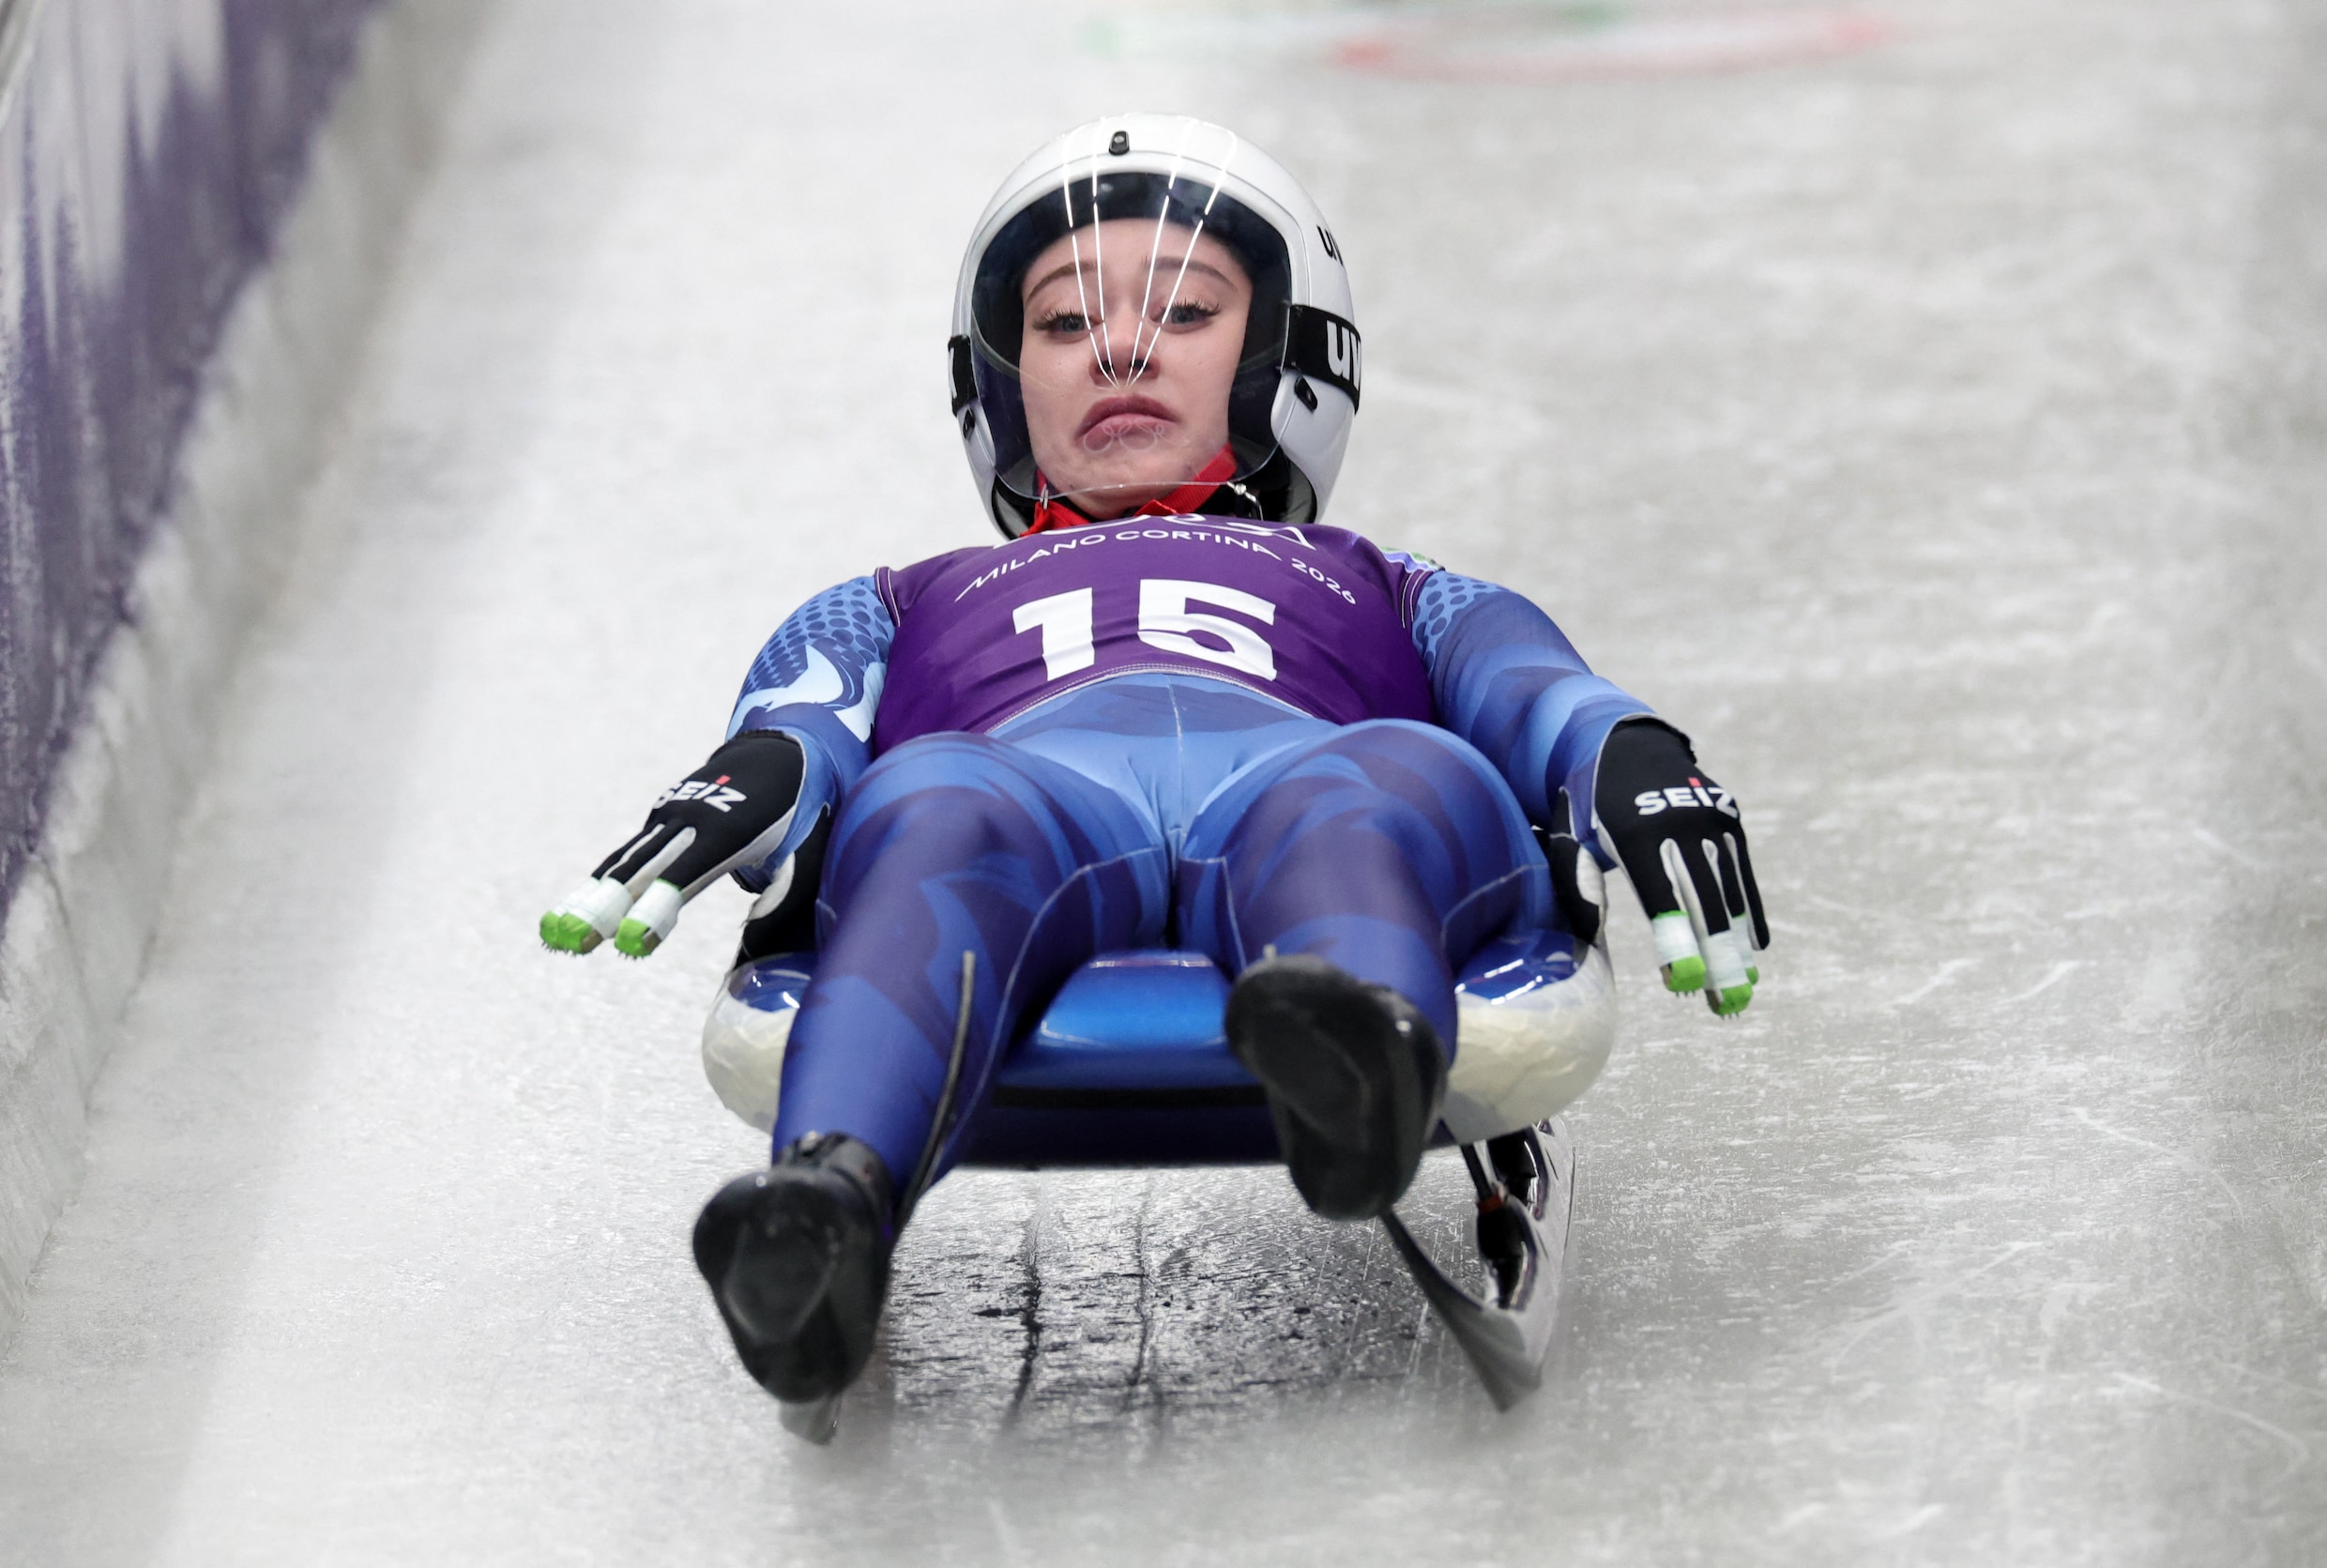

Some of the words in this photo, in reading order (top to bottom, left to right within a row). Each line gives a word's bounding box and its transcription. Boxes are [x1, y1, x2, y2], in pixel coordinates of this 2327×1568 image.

[954, 534, 1105, 601] MILANO
[1115, 529, 1283, 561] CORTINA
[1291, 557, 1357, 605] 2026
[1012, 579, 1276, 681] 15
